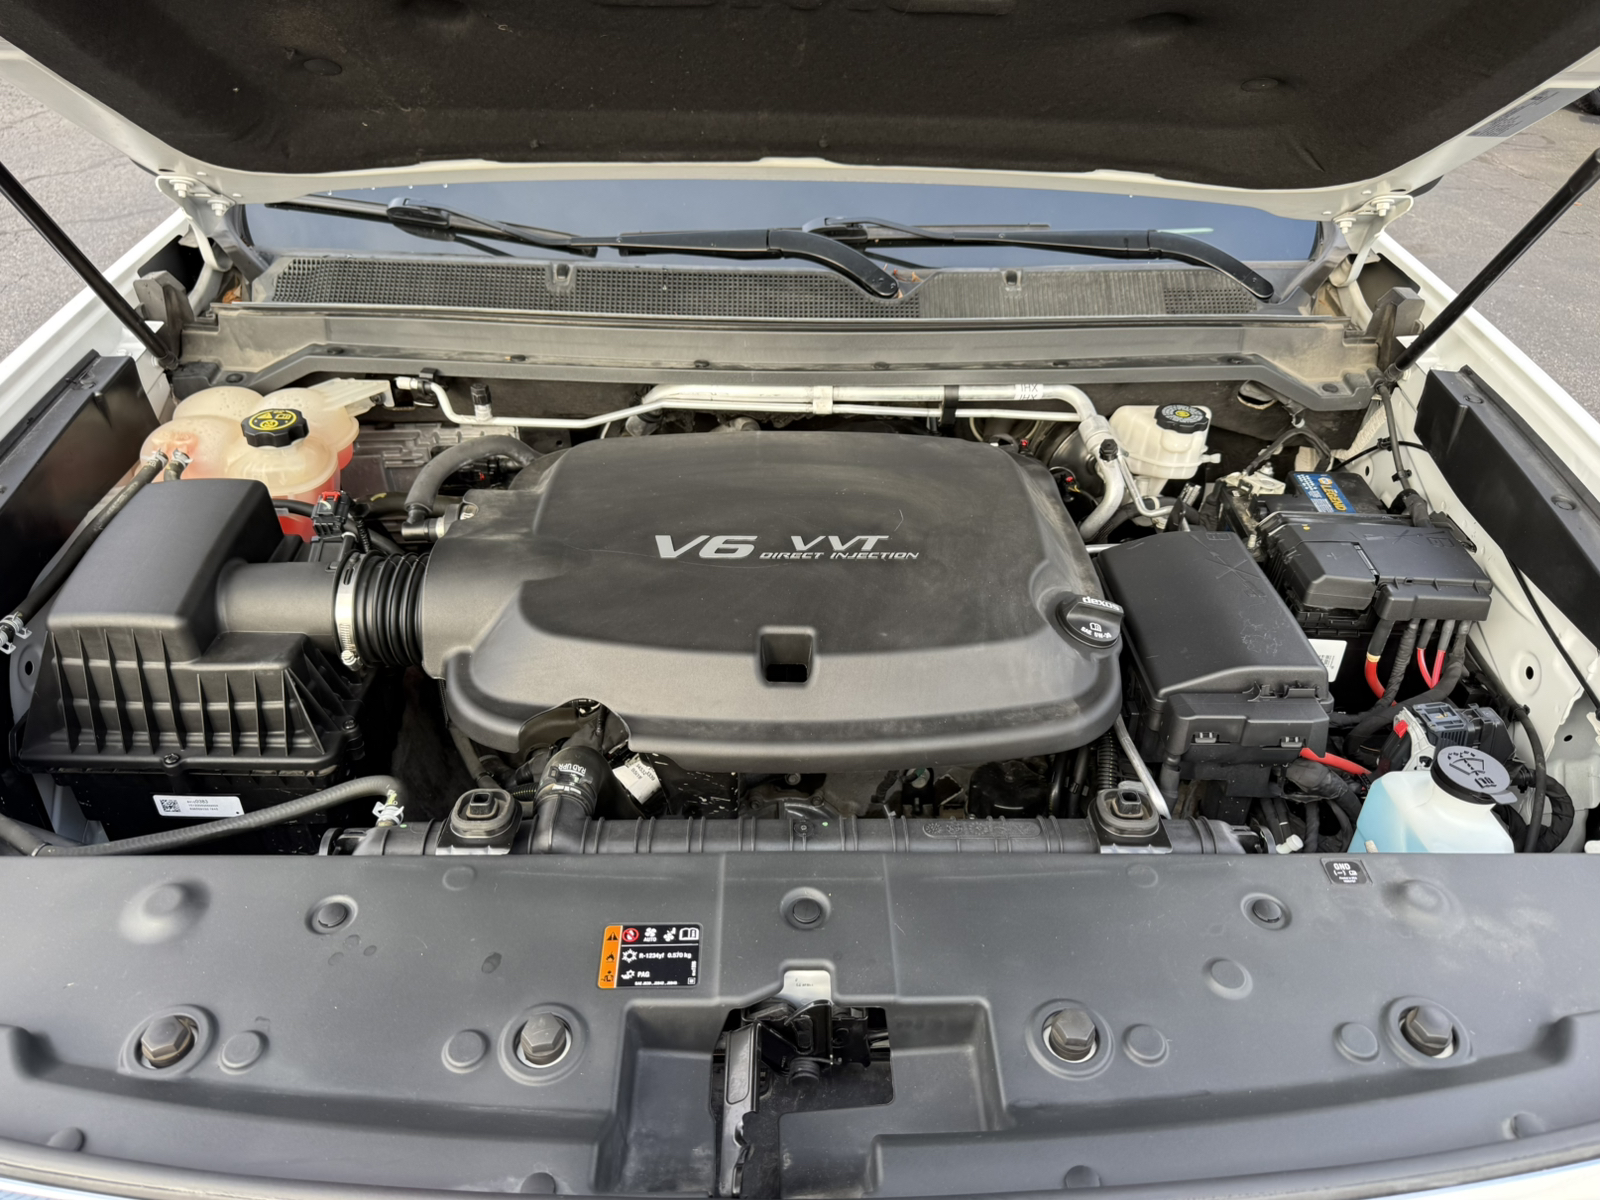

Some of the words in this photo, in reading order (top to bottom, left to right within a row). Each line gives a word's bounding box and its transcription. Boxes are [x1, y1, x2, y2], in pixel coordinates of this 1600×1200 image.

[1321, 485, 1347, 511] LEGEND
[655, 535, 757, 558] V6
[790, 535, 889, 551] VVT
[759, 552, 824, 560] DIRECT
[829, 552, 919, 560] INJECTION
[1082, 596, 1120, 611] dexos
[573, 764, 587, 775] RAD
[638, 952, 665, 960] R-1234yf
